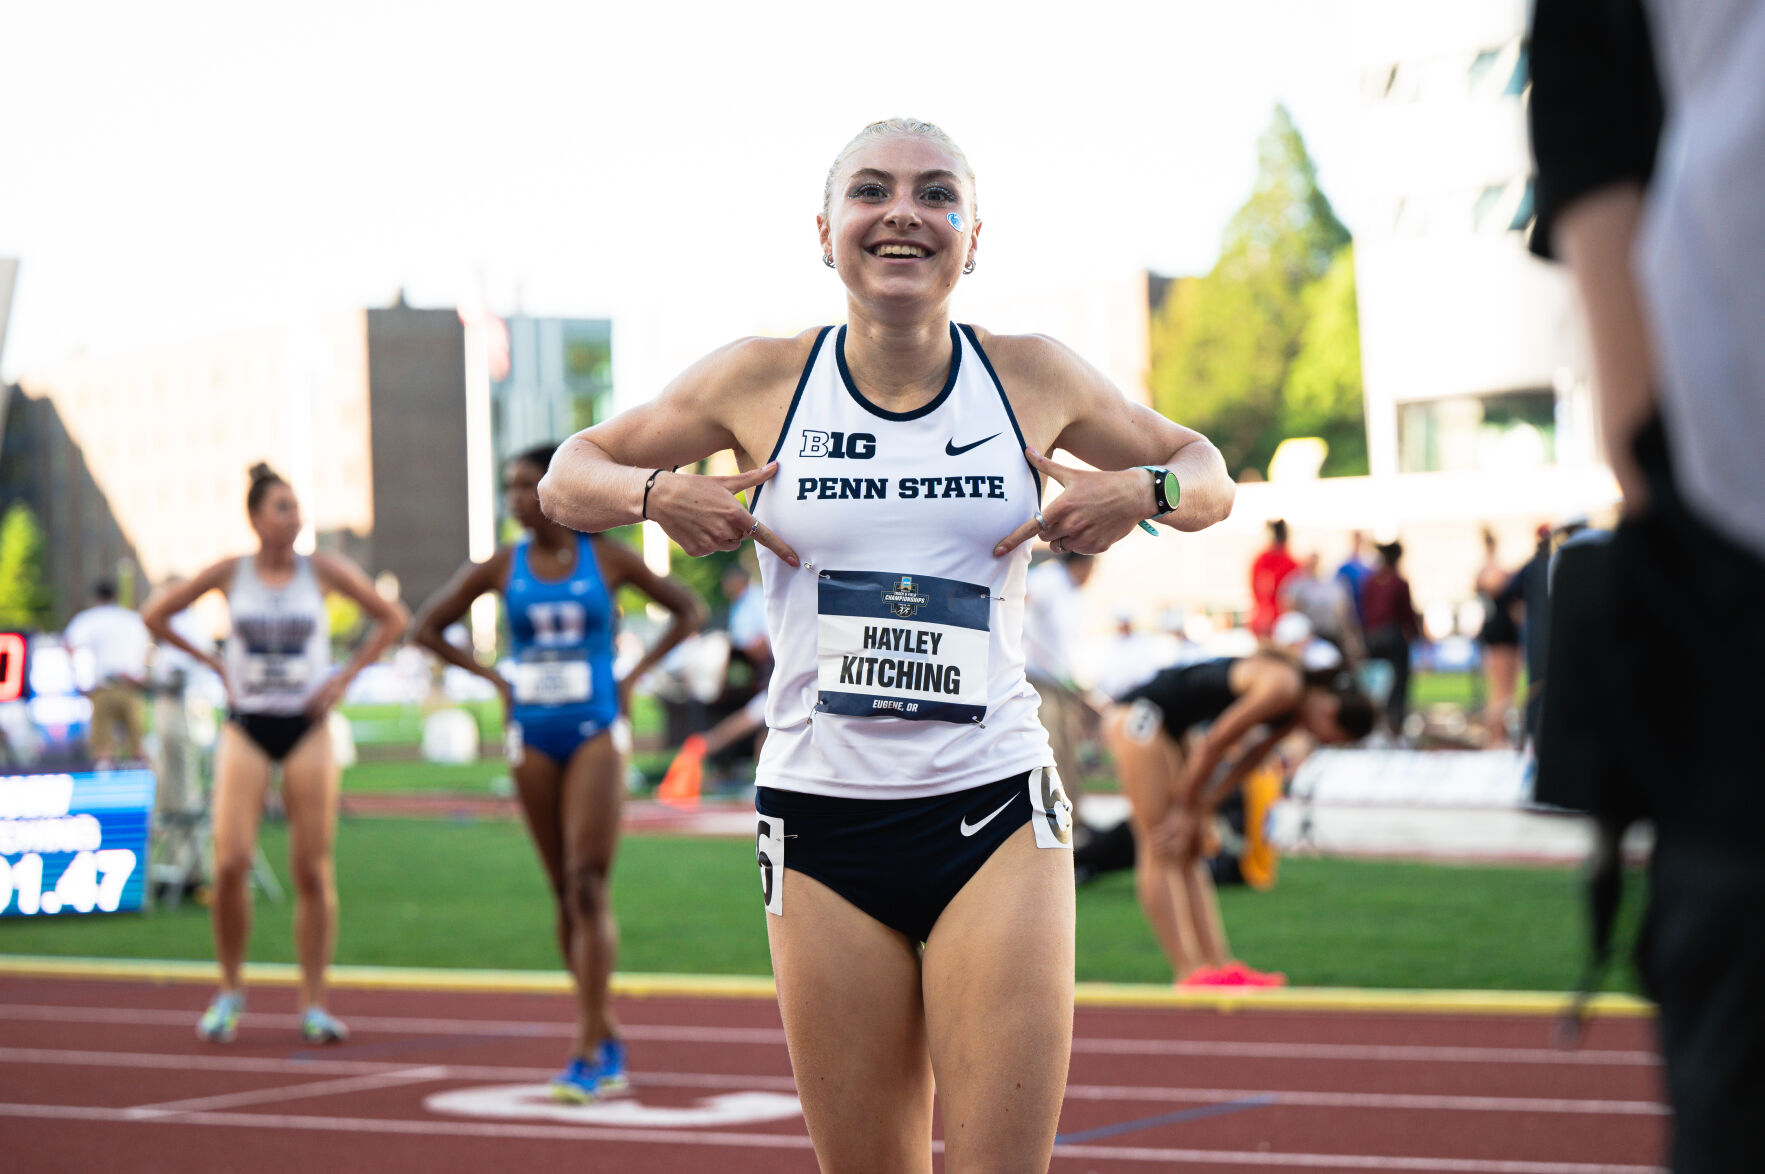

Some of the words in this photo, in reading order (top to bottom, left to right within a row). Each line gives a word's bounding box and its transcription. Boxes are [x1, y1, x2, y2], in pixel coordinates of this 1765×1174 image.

[797, 477, 889, 500] PENN
[898, 475, 1005, 499] STATE
[863, 625, 943, 656] HAYLEY
[839, 655, 961, 695] KITCHING
[872, 699, 904, 712] EUGENE,
[906, 702, 919, 713] OR
